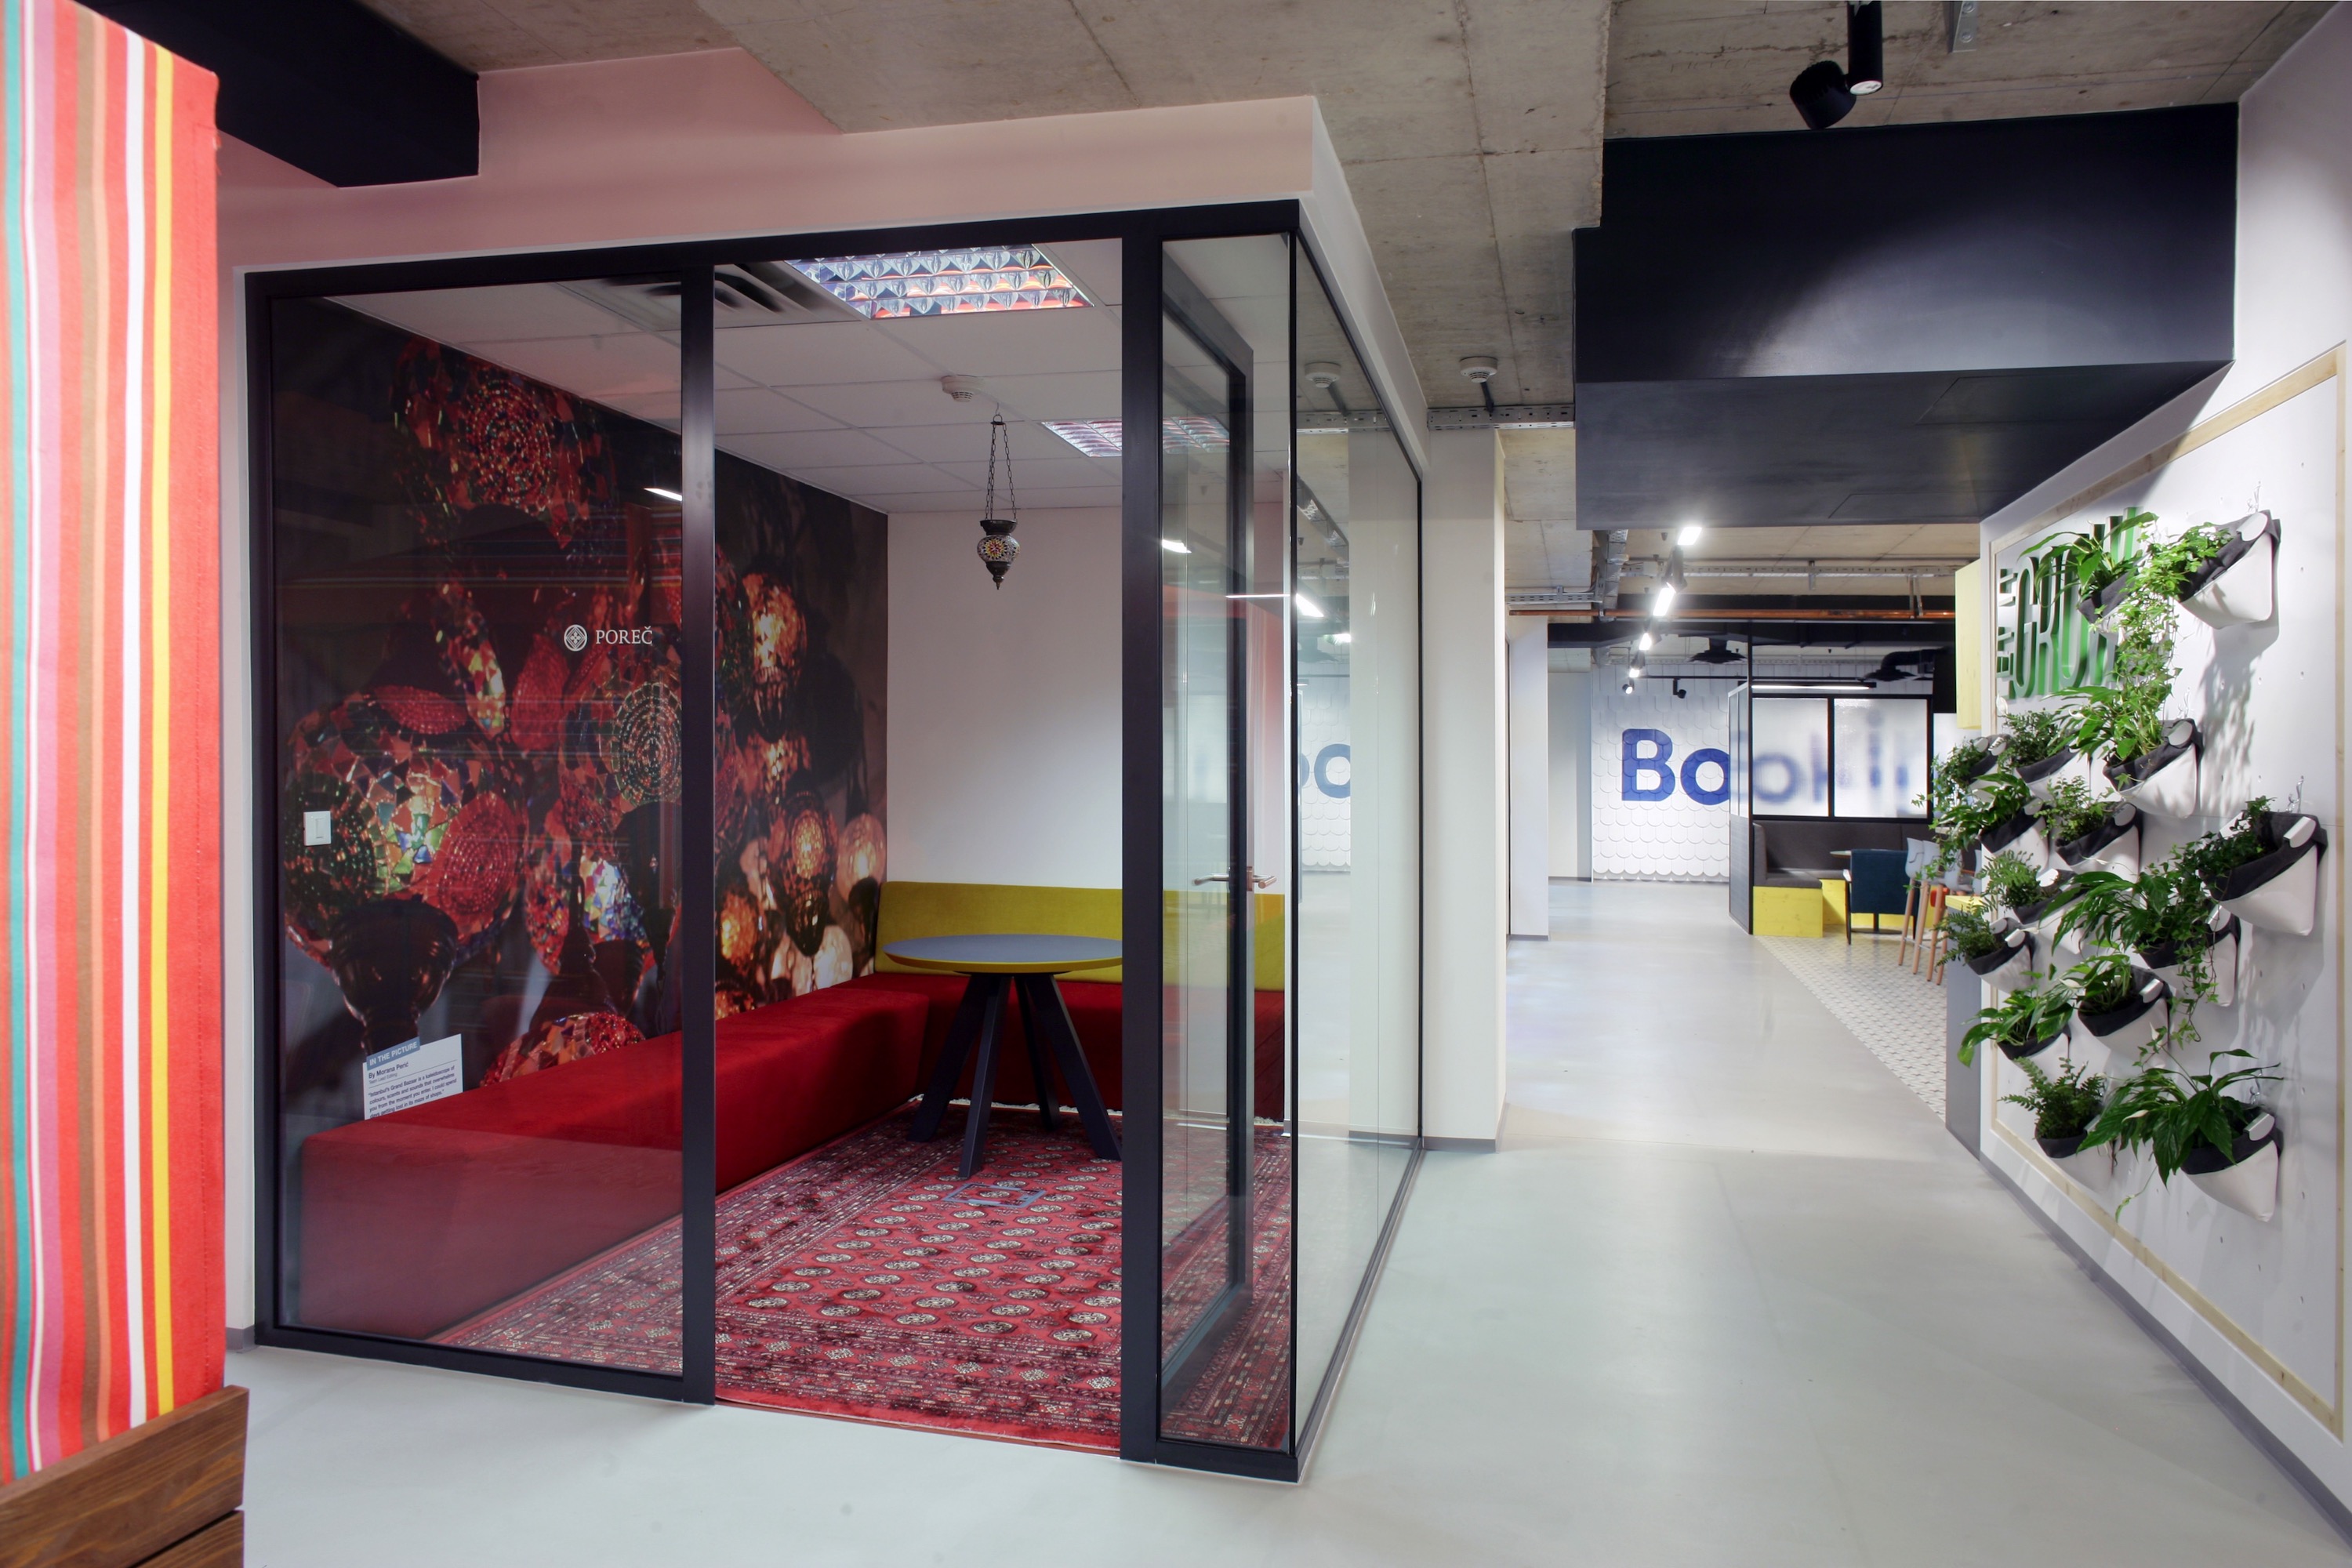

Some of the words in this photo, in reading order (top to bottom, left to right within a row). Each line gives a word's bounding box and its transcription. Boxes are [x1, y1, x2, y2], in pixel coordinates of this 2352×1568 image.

[596, 626, 653, 645] POREČ
[369, 1058, 376, 1066] IN
[378, 1052, 390, 1062] THE
[391, 1041, 418, 1057] PICTURE
